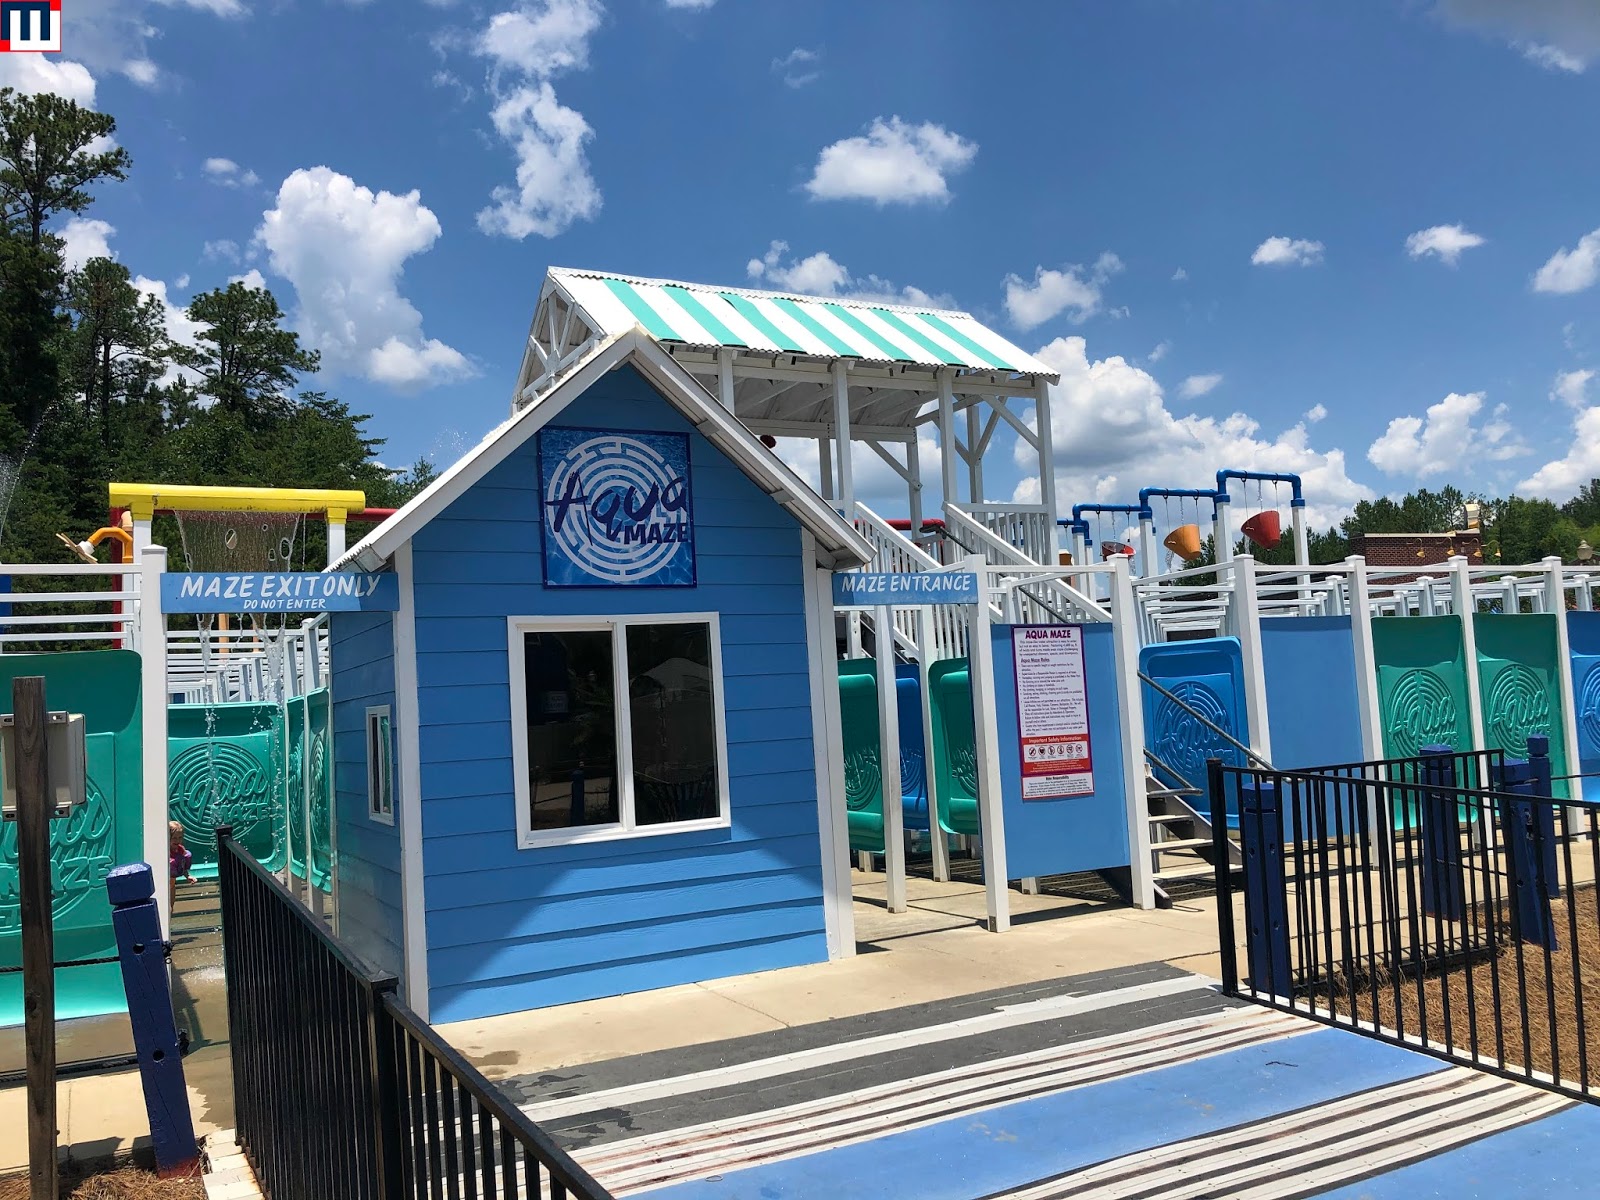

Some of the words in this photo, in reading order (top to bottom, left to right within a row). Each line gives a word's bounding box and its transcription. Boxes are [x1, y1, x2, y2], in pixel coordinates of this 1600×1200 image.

[545, 472, 687, 546] Aqua
[624, 523, 688, 545] MAZE
[181, 576, 254, 599] MAZE
[260, 575, 320, 598] EXIT
[323, 575, 381, 597] ONLY
[841, 576, 886, 593] MAZE
[890, 575, 971, 592] ENTRANCE
[243, 600, 257, 609] DO
[260, 600, 286, 609] NOT
[287, 598, 326, 609] ENTER
[1025, 630, 1048, 639] AQUA
[1050, 630, 1071, 639] MAZE
